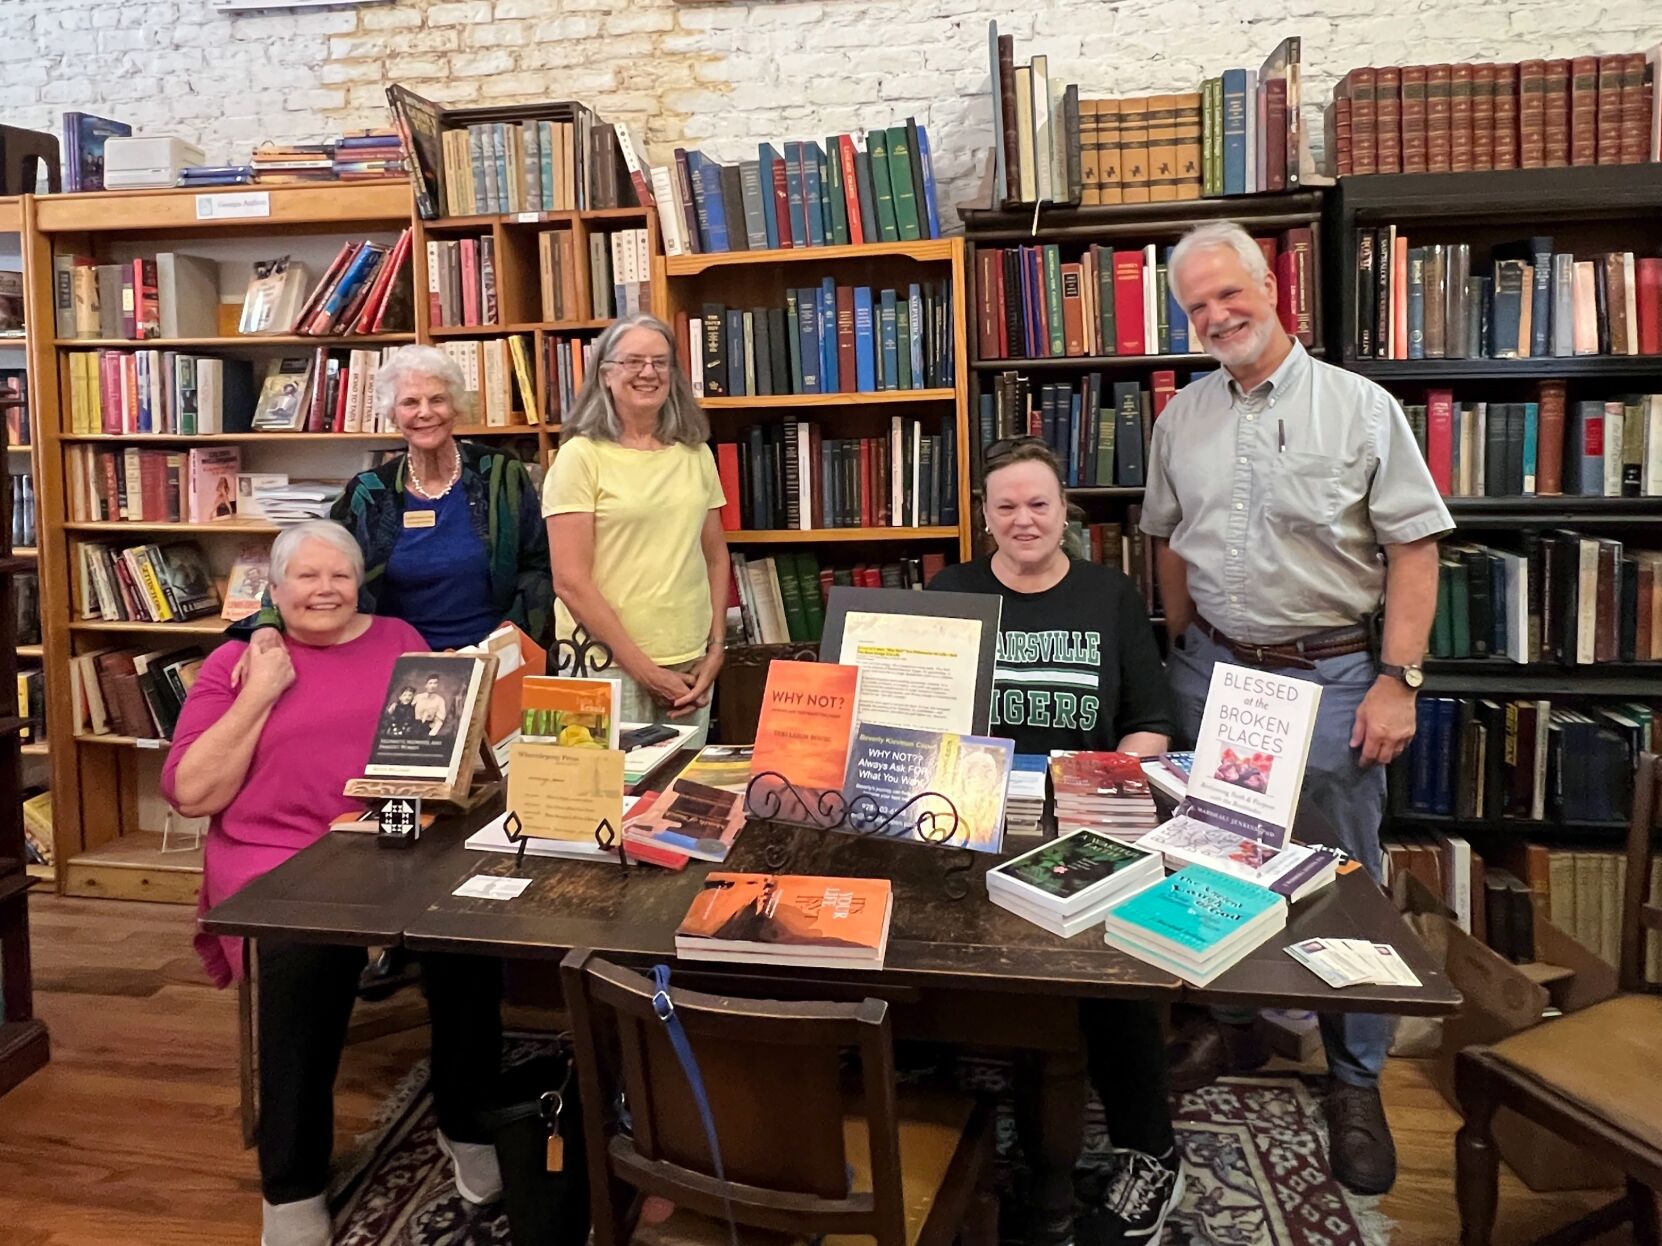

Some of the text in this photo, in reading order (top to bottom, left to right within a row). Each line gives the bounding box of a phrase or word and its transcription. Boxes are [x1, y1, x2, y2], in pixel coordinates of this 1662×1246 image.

[1223, 671, 1299, 702] BLESSED
[772, 690, 804, 705] WHY
[807, 694, 845, 709] NOT?
[1243, 697, 1270, 710] at the
[1219, 704, 1290, 736] BROKEN
[1217, 723, 1283, 754] PLACES
[868, 748, 924, 763] WHY NOT??
[858, 758, 928, 776] Always Ask FOR
[858, 770, 881, 780] What
[883, 773, 899, 783] You
[821, 888, 840, 907] LIFE
[832, 892, 853, 919] YOUR
